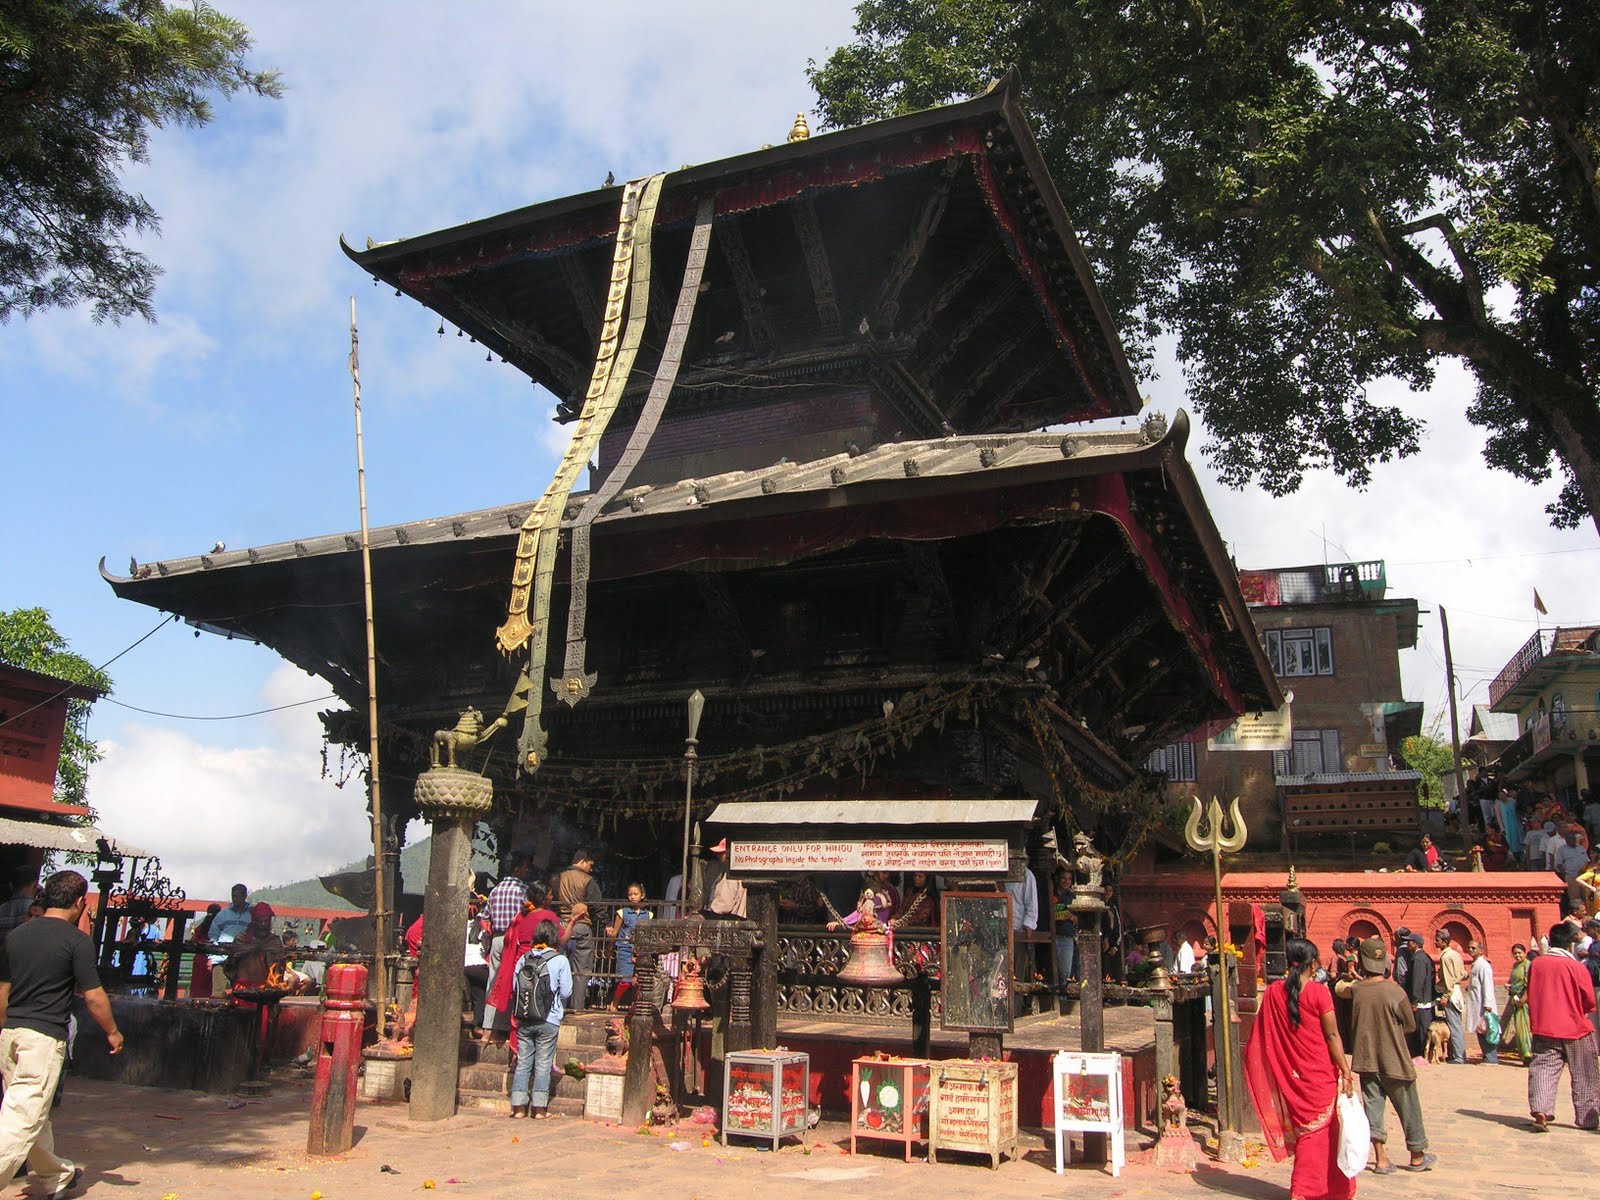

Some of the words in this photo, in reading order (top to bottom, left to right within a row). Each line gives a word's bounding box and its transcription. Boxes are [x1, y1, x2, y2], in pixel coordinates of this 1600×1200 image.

[734, 844, 778, 852] ENTRANCE
[805, 844, 821, 852] FOR
[826, 844, 852, 852] HINDU
[744, 856, 784, 865] Photographs
[785, 855, 805, 864] inside
